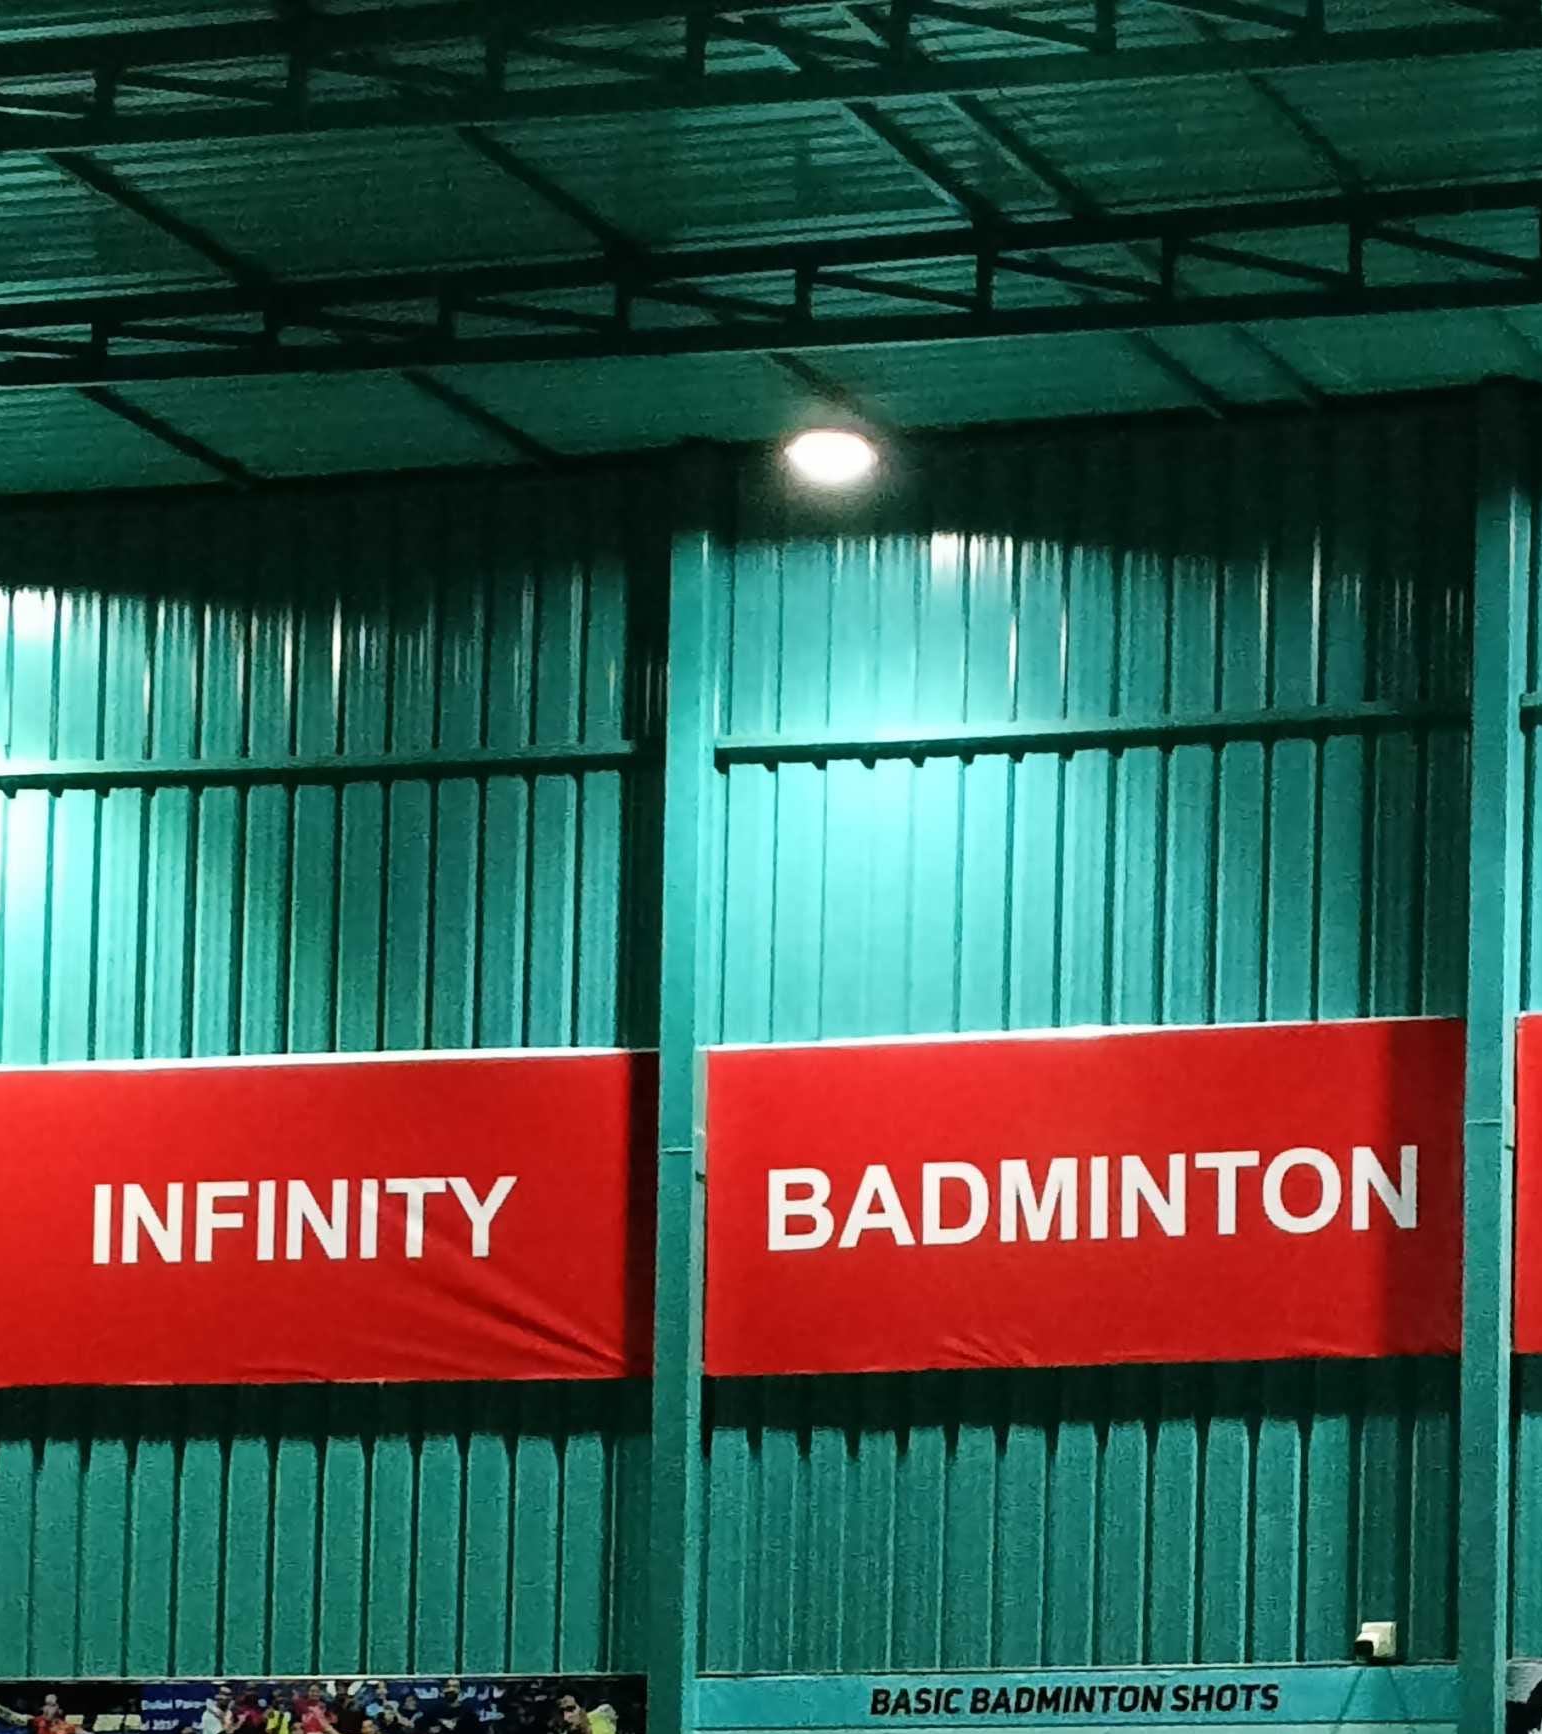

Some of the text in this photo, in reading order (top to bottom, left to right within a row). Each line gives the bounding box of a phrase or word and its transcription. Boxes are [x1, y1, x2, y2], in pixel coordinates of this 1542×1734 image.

[91, 1174, 519, 1268] INFINITY
[766, 1144, 1420, 1253] BADMINTON
[870, 1683, 1279, 1716] BASIC BADMINTON SHOTS
